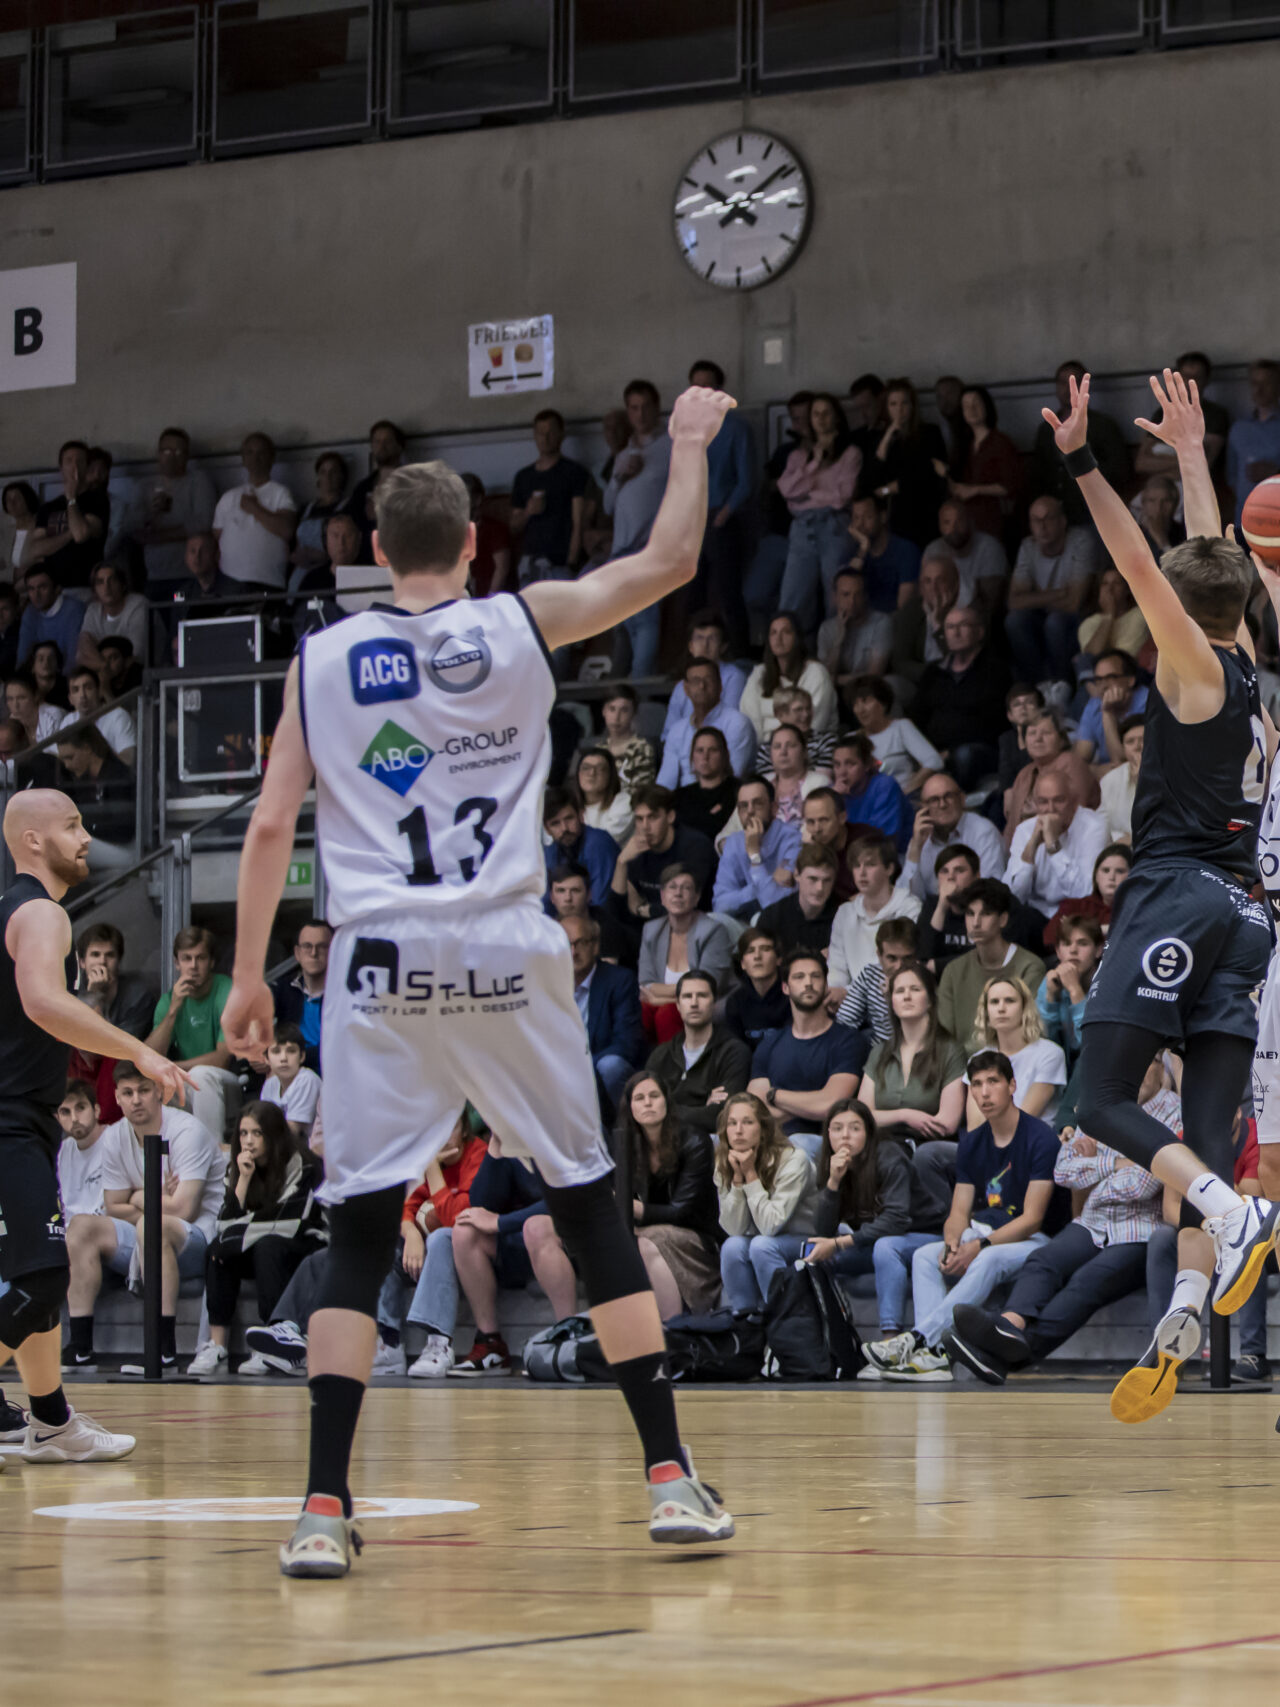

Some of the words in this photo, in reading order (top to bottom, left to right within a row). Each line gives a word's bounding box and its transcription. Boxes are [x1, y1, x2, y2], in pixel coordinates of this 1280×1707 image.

[14, 306, 43, 356] B
[359, 653, 410, 689] ACG
[433, 651, 481, 669] VOLVO
[449, 752, 523, 774] ENVIRONMENT
[397, 797, 498, 887] 13
[352, 1003, 389, 1016] PRINT
